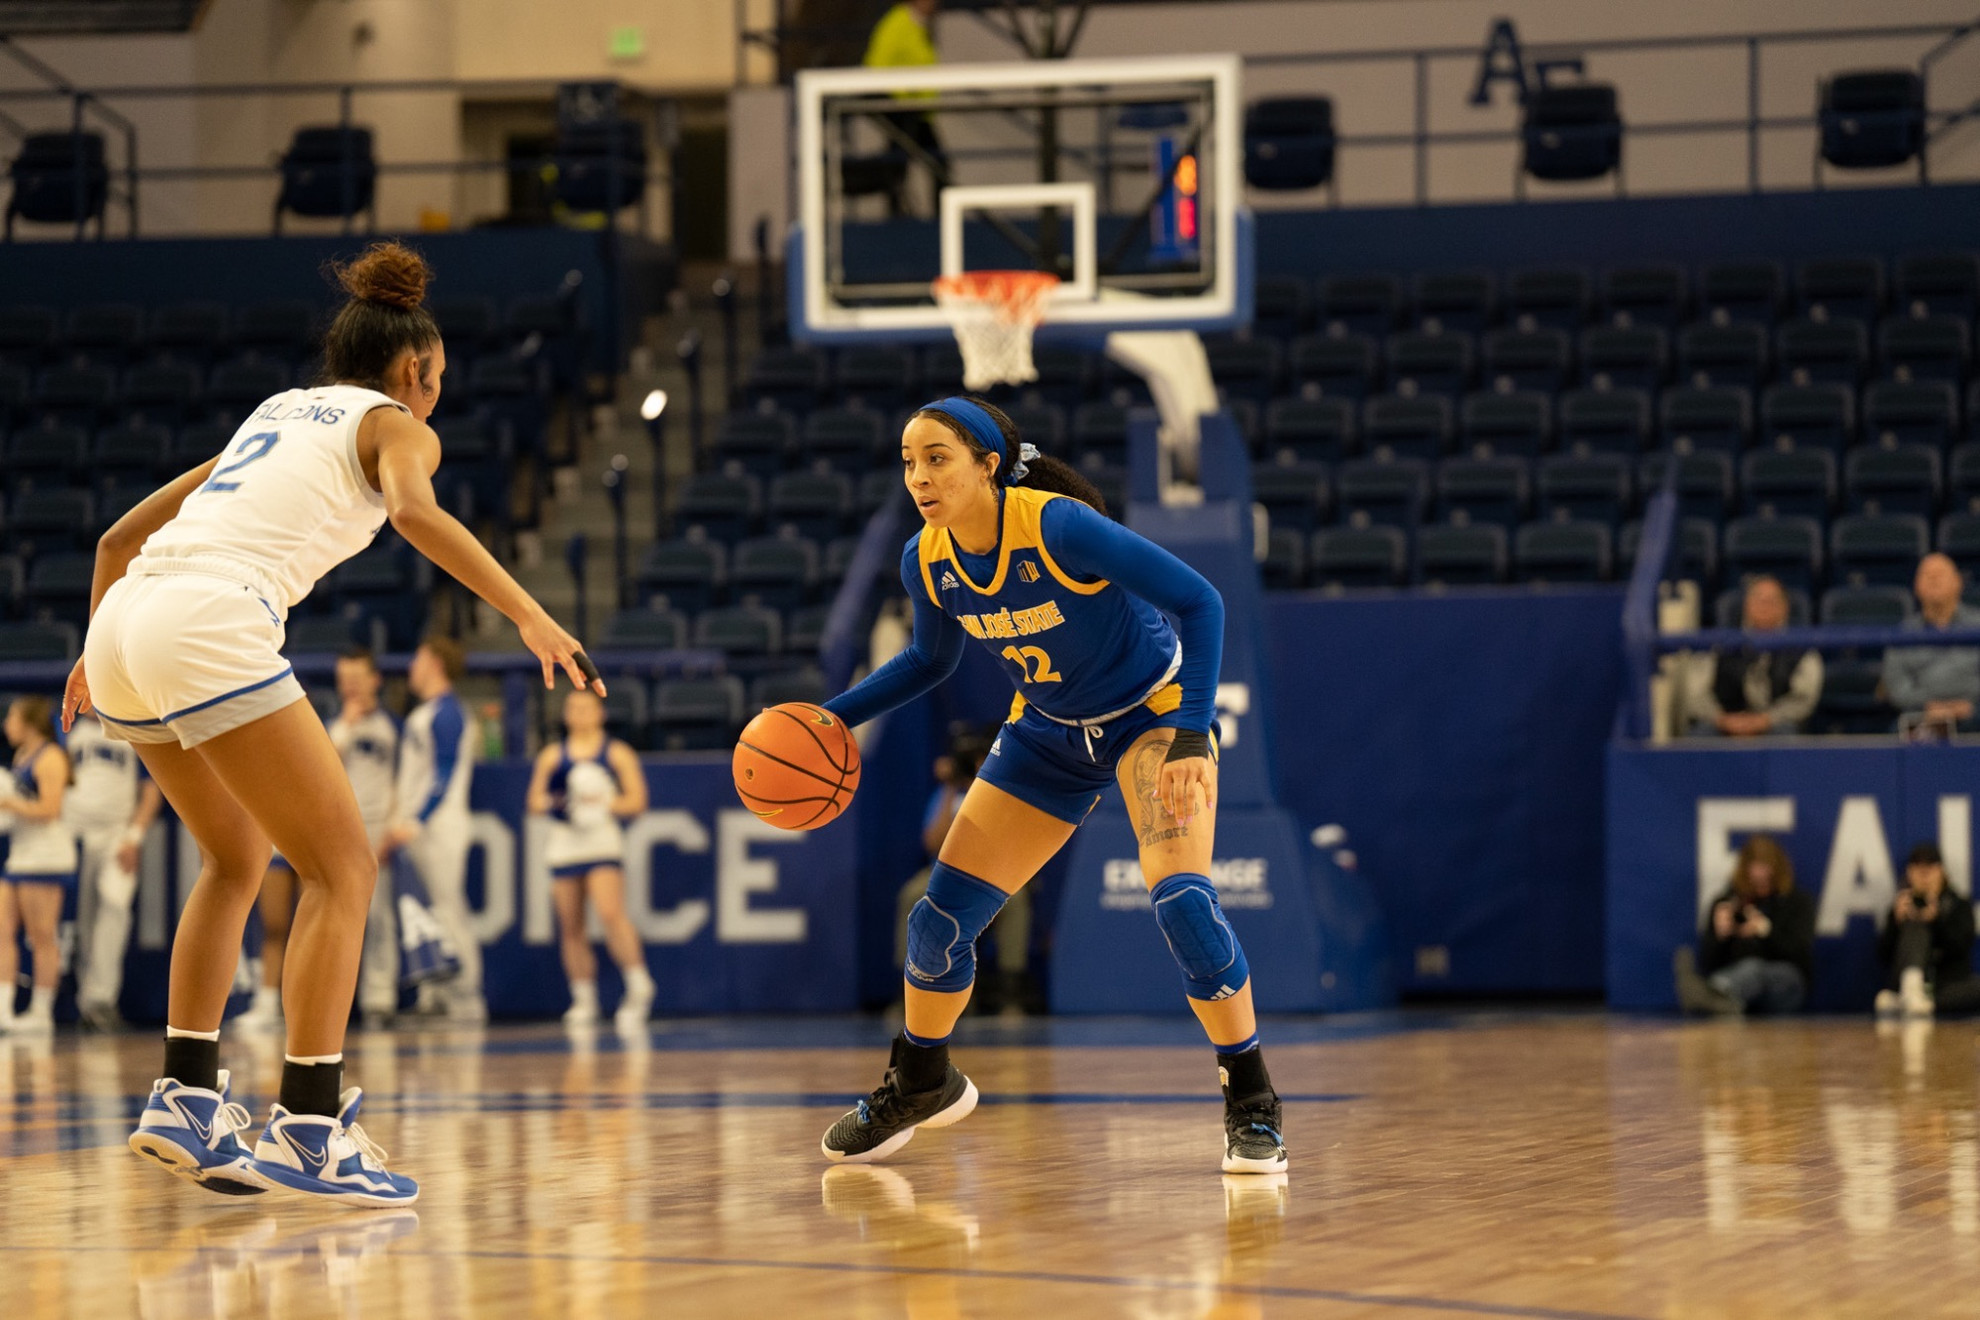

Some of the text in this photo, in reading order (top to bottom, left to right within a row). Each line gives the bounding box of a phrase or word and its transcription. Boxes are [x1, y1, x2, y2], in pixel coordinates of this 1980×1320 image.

[200, 430, 281, 493] 2
[1011, 600, 1066, 636] STATE
[1001, 645, 1062, 684] 12
